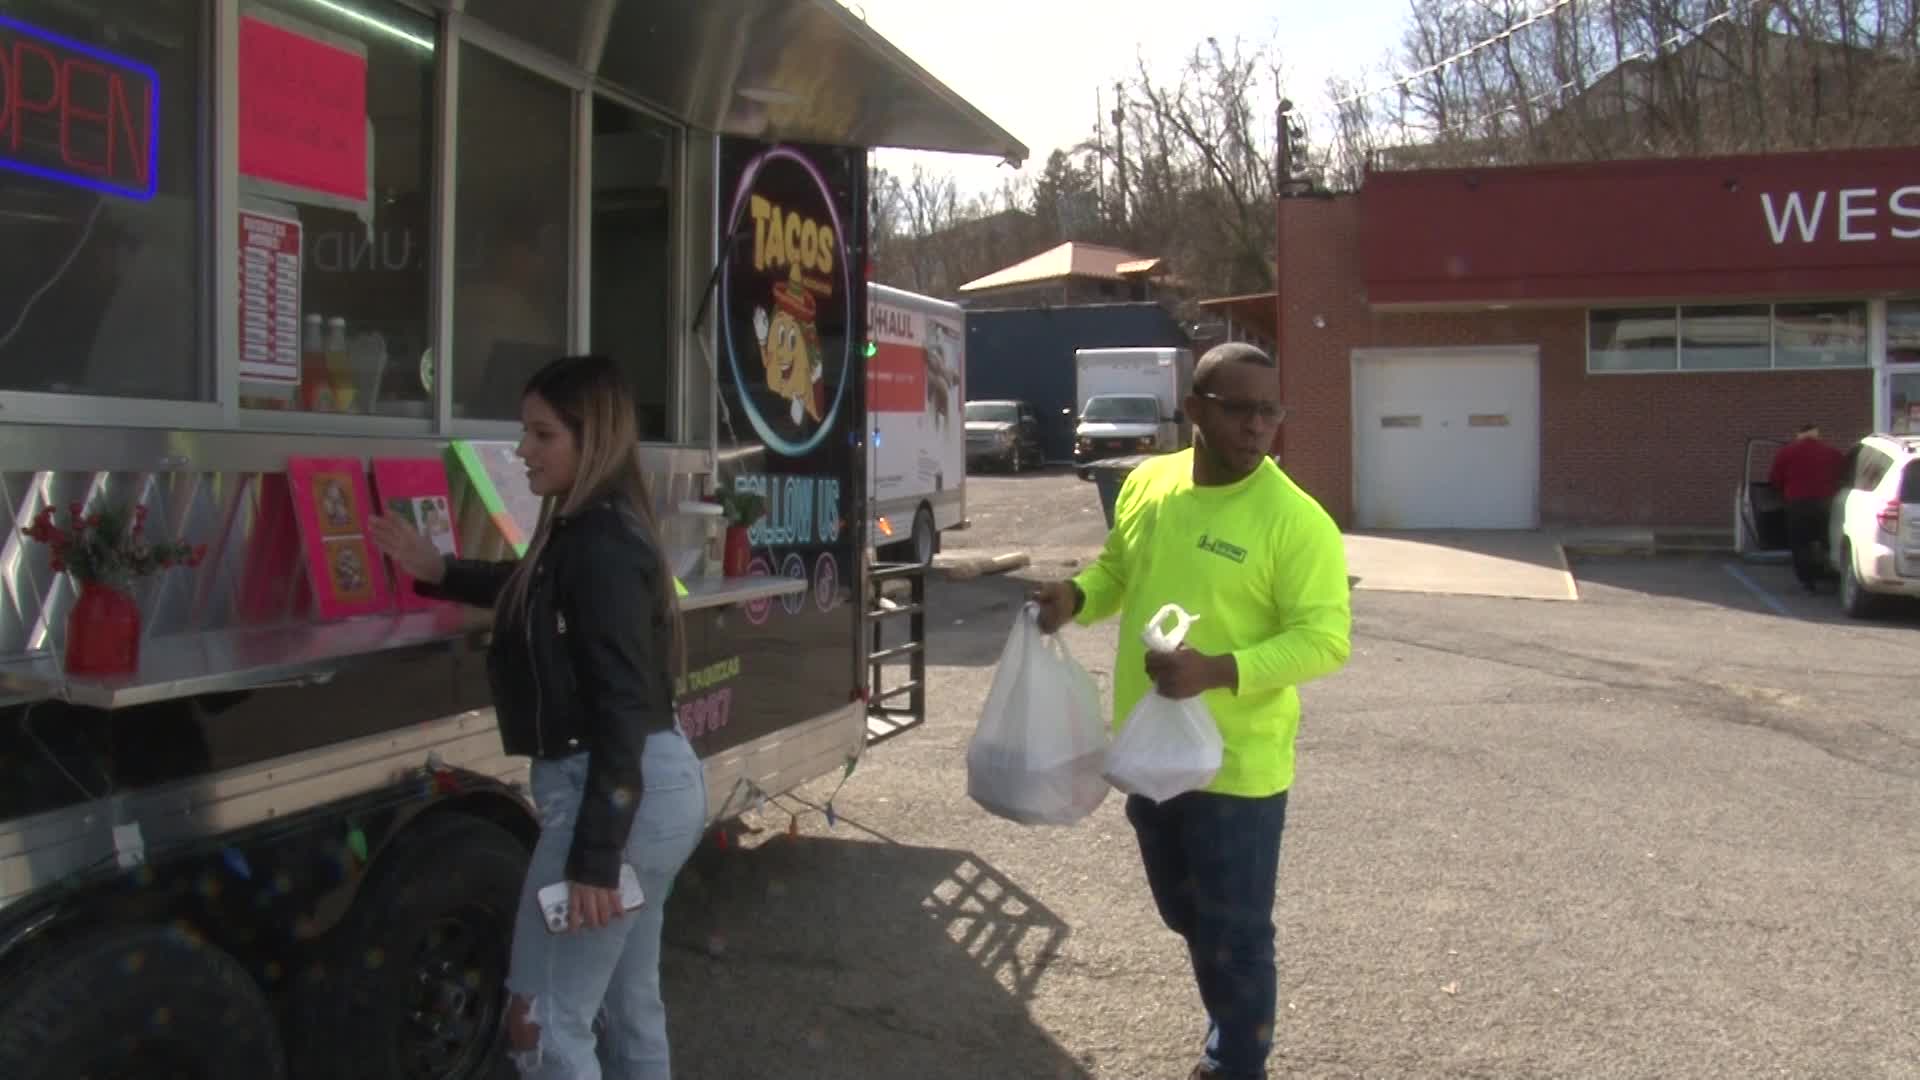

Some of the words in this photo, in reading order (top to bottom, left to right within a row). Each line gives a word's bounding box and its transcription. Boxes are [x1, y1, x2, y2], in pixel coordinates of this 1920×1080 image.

[0, 40, 152, 184] PEN
[751, 195, 834, 275] TACOS
[1760, 184, 1920, 244] WES
[817, 478, 840, 543] US
